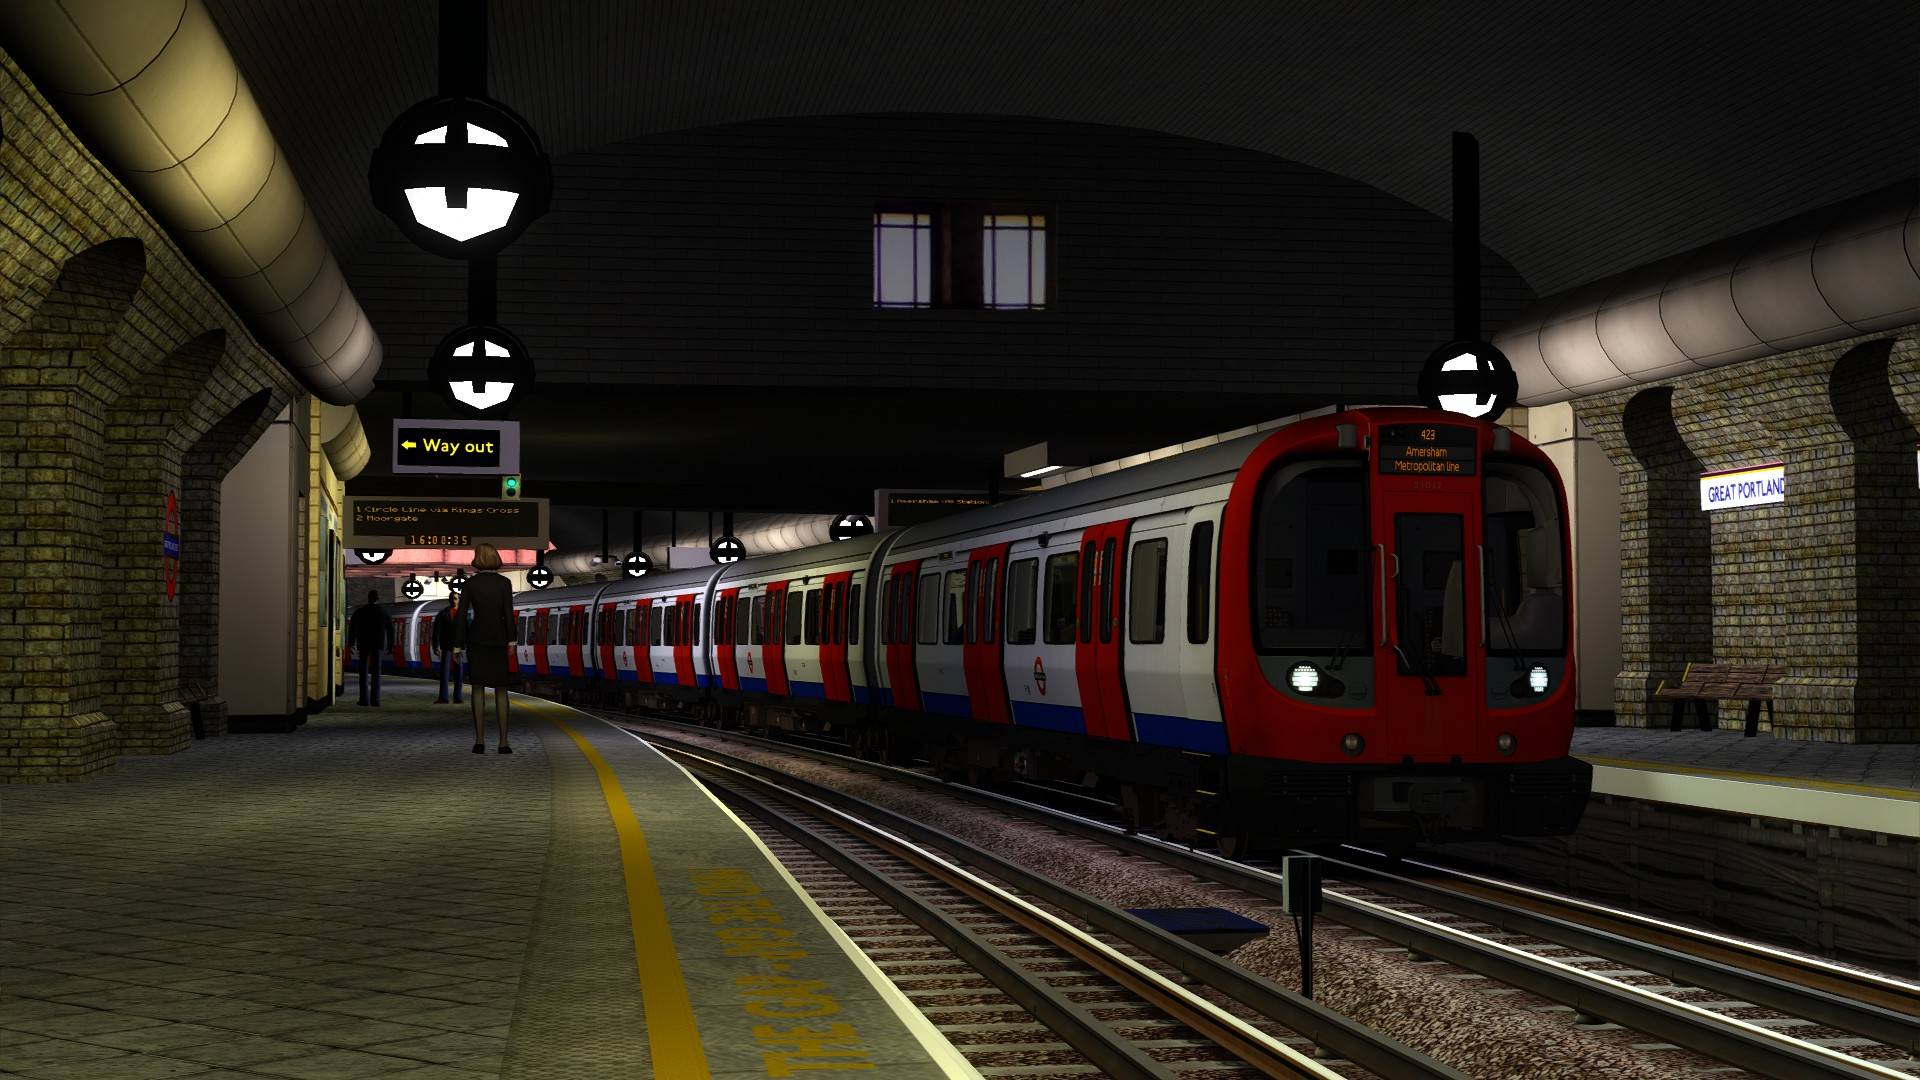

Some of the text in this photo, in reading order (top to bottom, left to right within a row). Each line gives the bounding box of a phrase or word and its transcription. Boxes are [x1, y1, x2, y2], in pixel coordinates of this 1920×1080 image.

[1421, 429, 1436, 440] 423
[423, 438, 494, 457] Way out
[1405, 446, 1448, 457] Amersham
[1394, 460, 1460, 473] Metropolitan line
[1708, 484, 1737, 503] GREAT
[735, 975, 877, 1078] THE GAP
